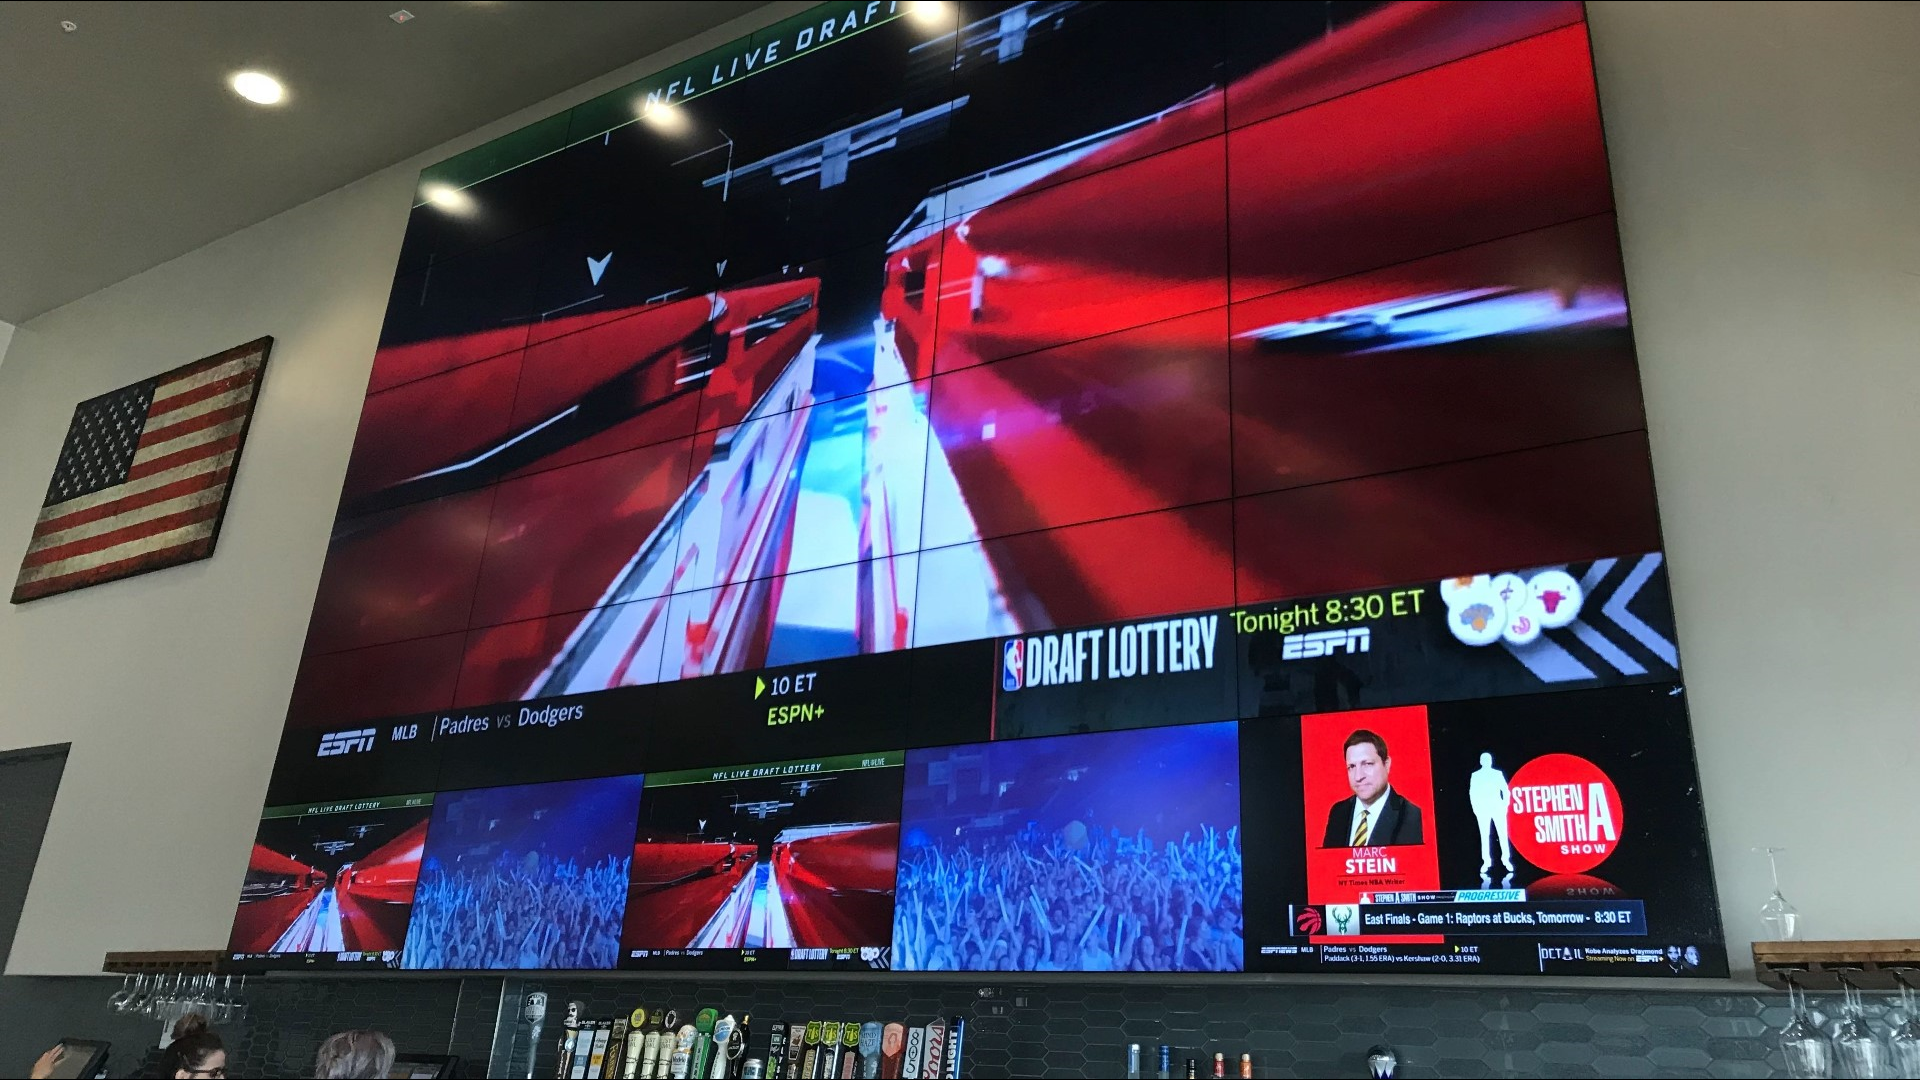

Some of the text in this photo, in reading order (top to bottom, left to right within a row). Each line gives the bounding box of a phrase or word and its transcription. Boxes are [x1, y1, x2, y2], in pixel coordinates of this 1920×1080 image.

[644, 76, 696, 111] NFL
[711, 39, 781, 85] LIVE
[1230, 589, 1424, 635] Tonight 8:30 ET
[1025, 615, 1218, 687] DRAFT LOTTERY
[1282, 630, 1370, 661] ESPN
[771, 674, 817, 696] 10 ET
[438, 702, 583, 736] Padres vs Dodgers
[767, 704, 825, 727] ESPN+
[316, 727, 377, 757] ESPN
[391, 723, 418, 742] MLB
[712, 763, 822, 780] NFL LIVE DRAFT LOTTERY
[1513, 785, 1583, 814] STEPHEN
[1588, 783, 1615, 841] A
[1535, 814, 1587, 843] SMITH
[1353, 847, 1387, 857] MARC
[1561, 844, 1605, 855] SHOW
[1346, 858, 1396, 873] STEIN
[1349, 879, 1368, 887] Times
[1369, 878, 1384, 886] NBA
[1458, 890, 1521, 901] PROGRESSIVE
[1365, 912, 1384, 925] East
[1385, 912, 1411, 925] Finals
[1418, 911, 1444, 925] Game
[1445, 911, 1454, 924] 1:
[1456, 910, 1492, 926] Raptors
[1493, 910, 1502, 924] at
[1504, 910, 1536, 926] Bucks,
[1537, 910, 1584, 924] Tomorrow
[1594, 911, 1617, 924] 8:30
[1618, 911, 1632, 923] ET
[1324, 945, 1347, 953] Padres
[1359, 945, 1388, 955] Dodgers
[1324, 954, 1350, 963] Paddack
[1404, 954, 1431, 963] Kershaw
[1602, 947, 1629, 956] Analyzes
[1631, 948, 1663, 956] Draymond
[906, 1031, 920, 1074] 805
[946, 1030, 958, 1072] LIGHT
